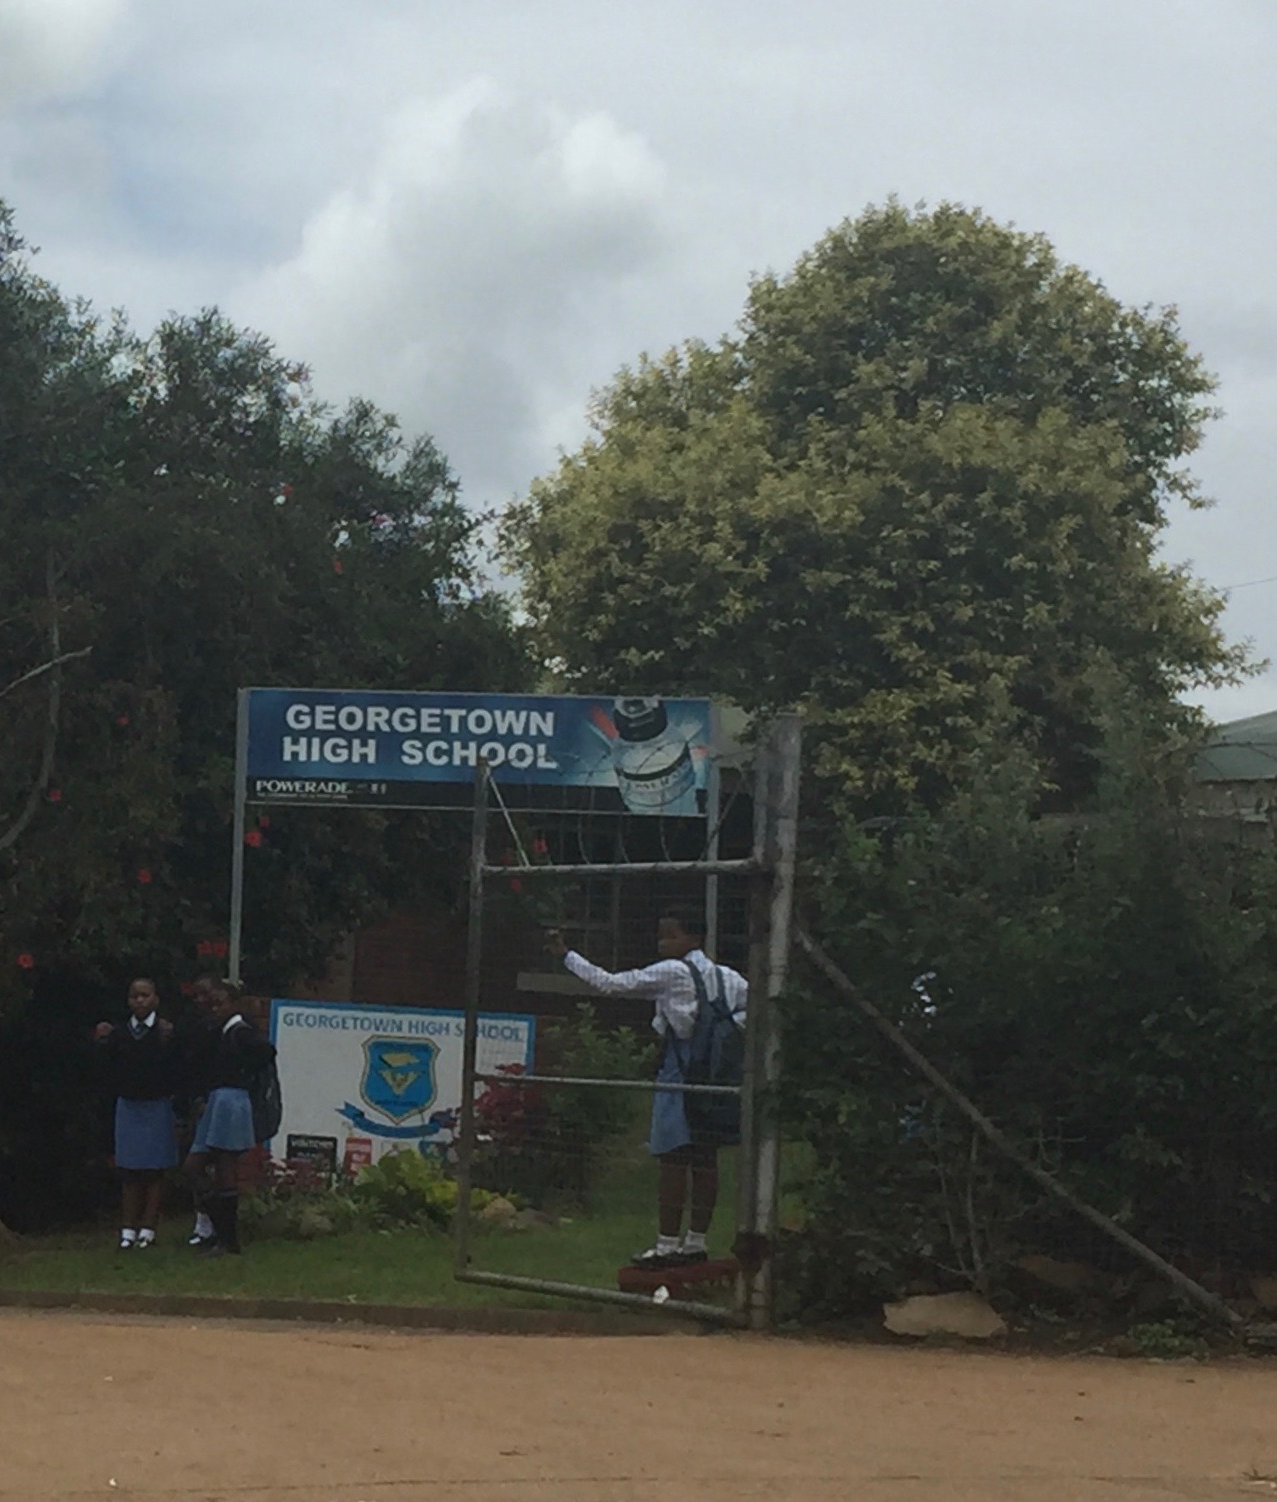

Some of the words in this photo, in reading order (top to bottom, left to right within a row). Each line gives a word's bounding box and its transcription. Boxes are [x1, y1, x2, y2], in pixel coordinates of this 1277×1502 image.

[285, 703, 555, 737] GEORGETOWN
[282, 736, 377, 764] HIGH
[400, 739, 557, 769] SCHOOL
[255, 780, 353, 795] POWERADE
[283, 1012, 403, 1033] GEORGETOWN
[408, 1020, 451, 1036] HIGH
[454, 1023, 523, 1042] SHOOL
